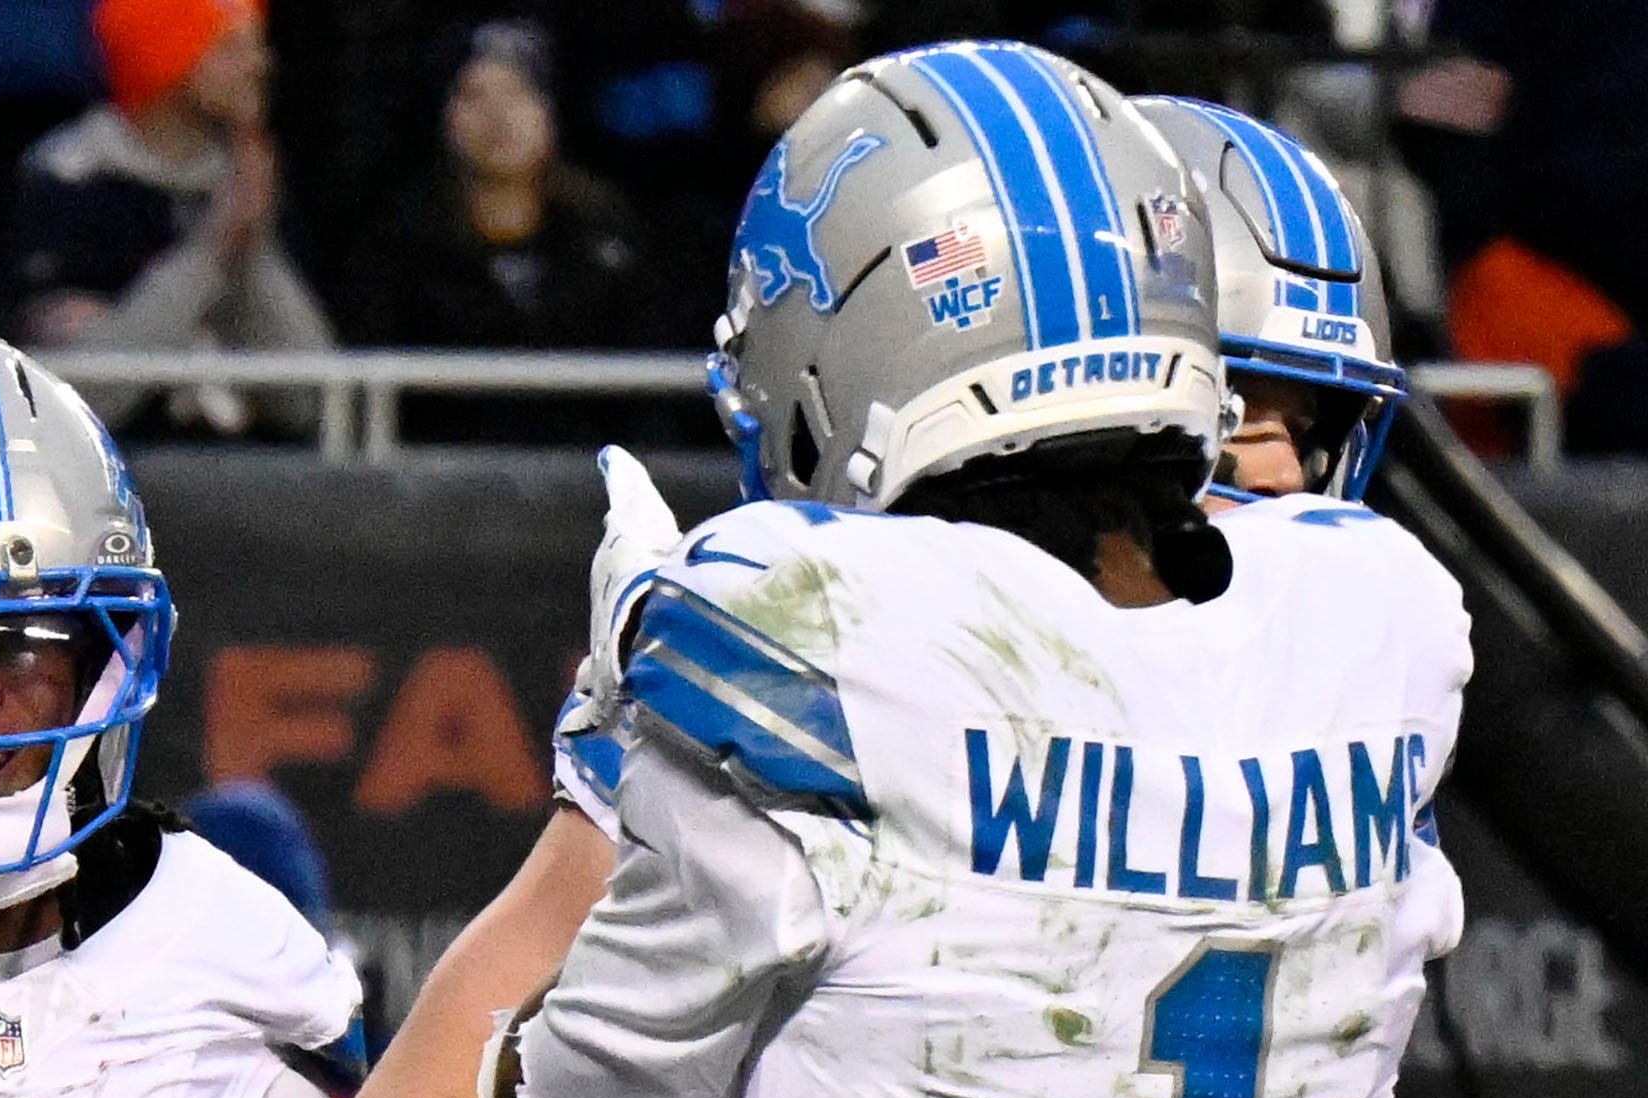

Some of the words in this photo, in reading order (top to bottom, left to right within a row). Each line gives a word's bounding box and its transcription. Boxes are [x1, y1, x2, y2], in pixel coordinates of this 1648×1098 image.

[928, 277, 1002, 324] WCF
[1098, 294, 1112, 321] 1
[1011, 351, 1162, 402] DETROIT
